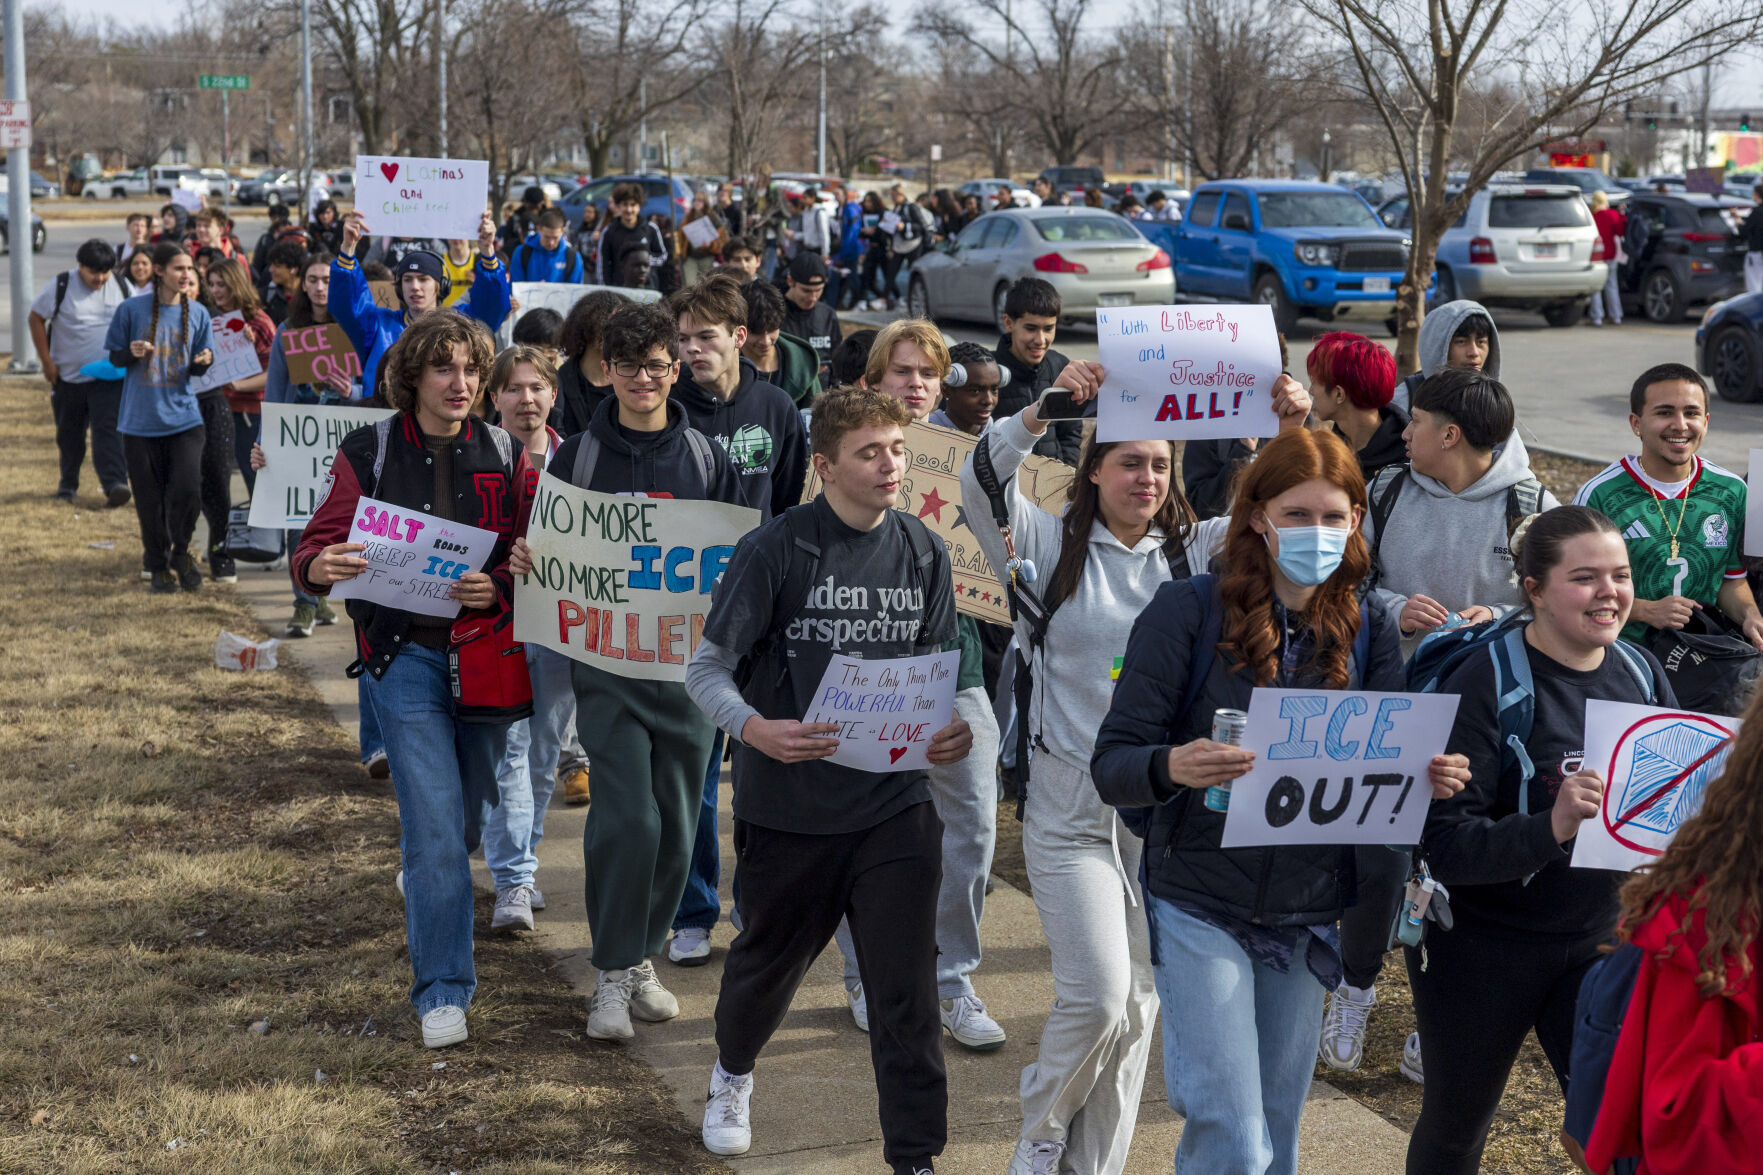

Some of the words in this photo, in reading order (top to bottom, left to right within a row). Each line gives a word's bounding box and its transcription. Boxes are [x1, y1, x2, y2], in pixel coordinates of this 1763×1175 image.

[364, 160, 375, 178] I
[400, 188, 423, 200] and
[281, 326, 332, 356] ICE
[1161, 310, 1239, 342] Liberty
[311, 351, 363, 381] OUT
[1138, 344, 1165, 362] and
[1169, 359, 1256, 387] Justice
[1120, 389, 1143, 404] for
[280, 414, 320, 448] NO
[356, 505, 426, 544] SALT
[531, 486, 574, 534] NO
[580, 500, 658, 543] MORE
[421, 555, 471, 581] ICE
[523, 555, 565, 593] NO
[568, 561, 630, 604] MORE
[804, 575, 869, 610] iden
[785, 612, 921, 650] erspective
[842, 663, 869, 687] The
[878, 667, 901, 695] Only
[905, 665, 927, 697] Thing
[930, 660, 950, 682] More
[821, 686, 906, 713] POWERFUL
[912, 695, 936, 713] Than
[878, 722, 931, 743] LOVE
[1264, 773, 1415, 829] OUT!
